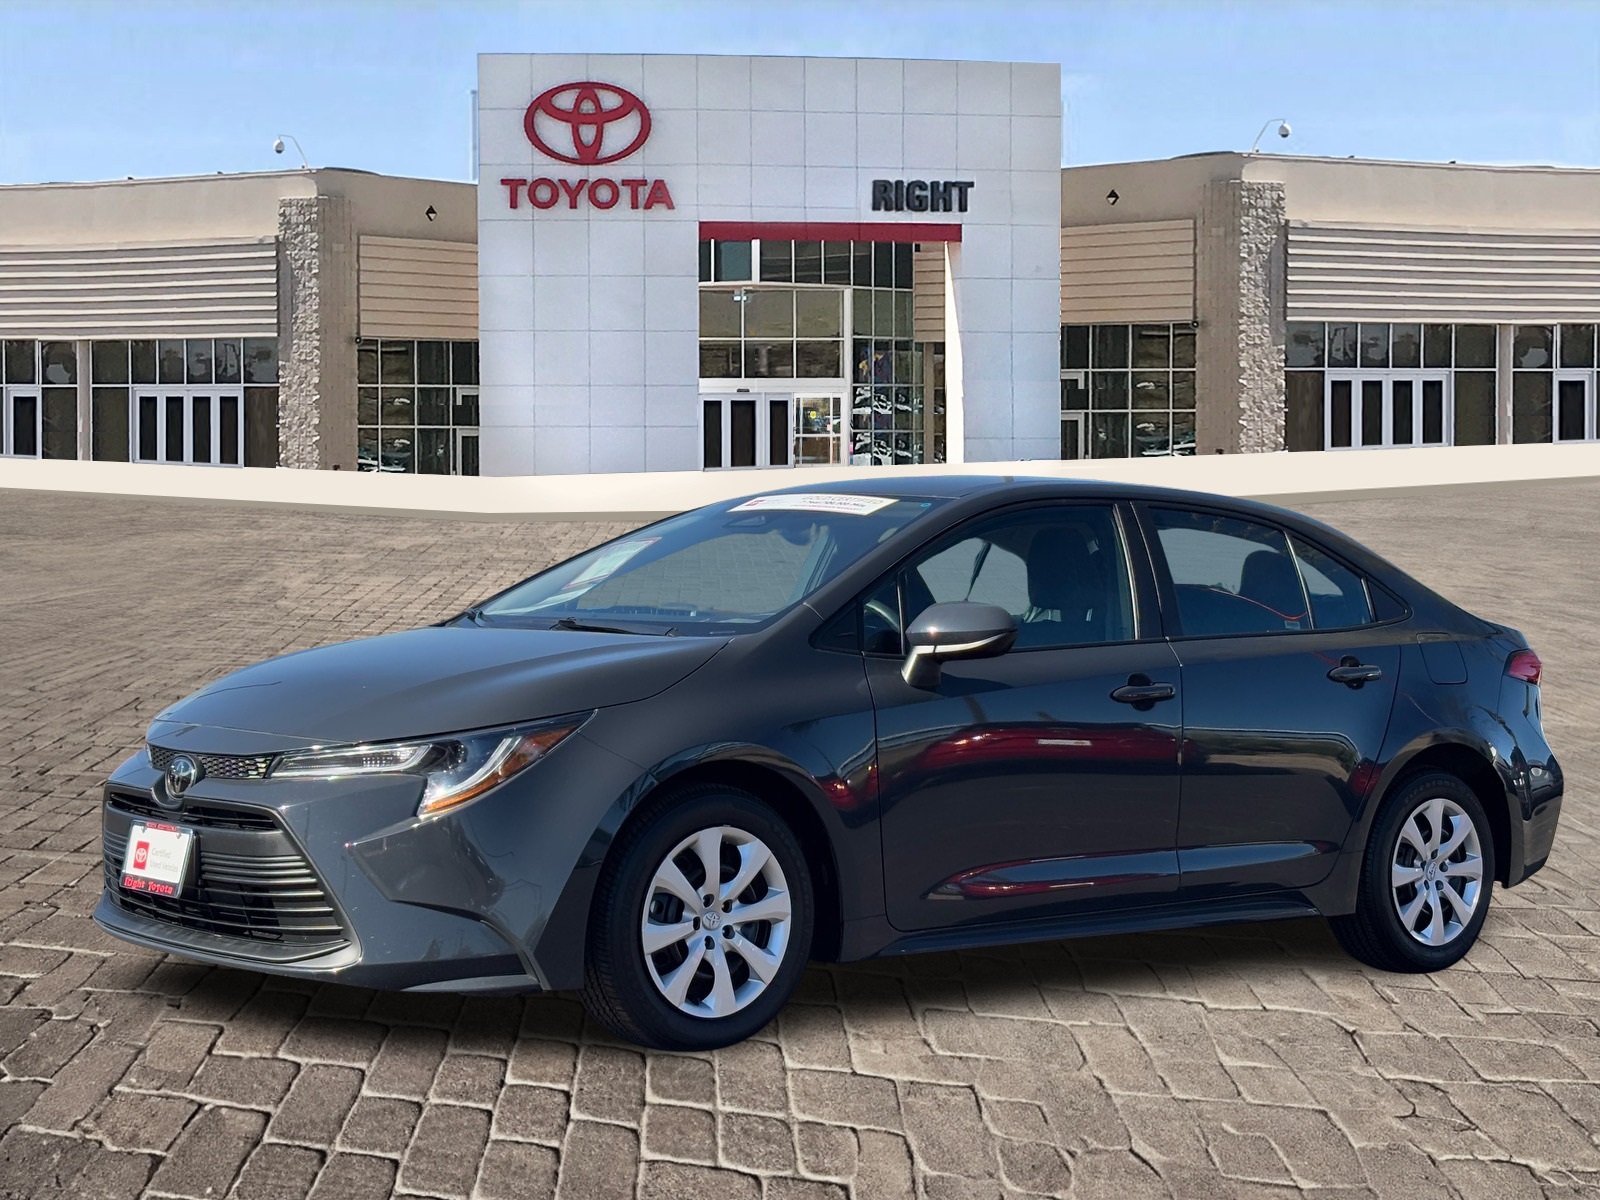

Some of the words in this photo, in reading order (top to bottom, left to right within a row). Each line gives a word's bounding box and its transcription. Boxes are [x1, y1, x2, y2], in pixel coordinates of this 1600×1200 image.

[500, 178, 675, 210] TOYOTA
[872, 180, 975, 212] RIGHT
[124, 875, 146, 890] Right
[148, 880, 174, 895] Toyota
